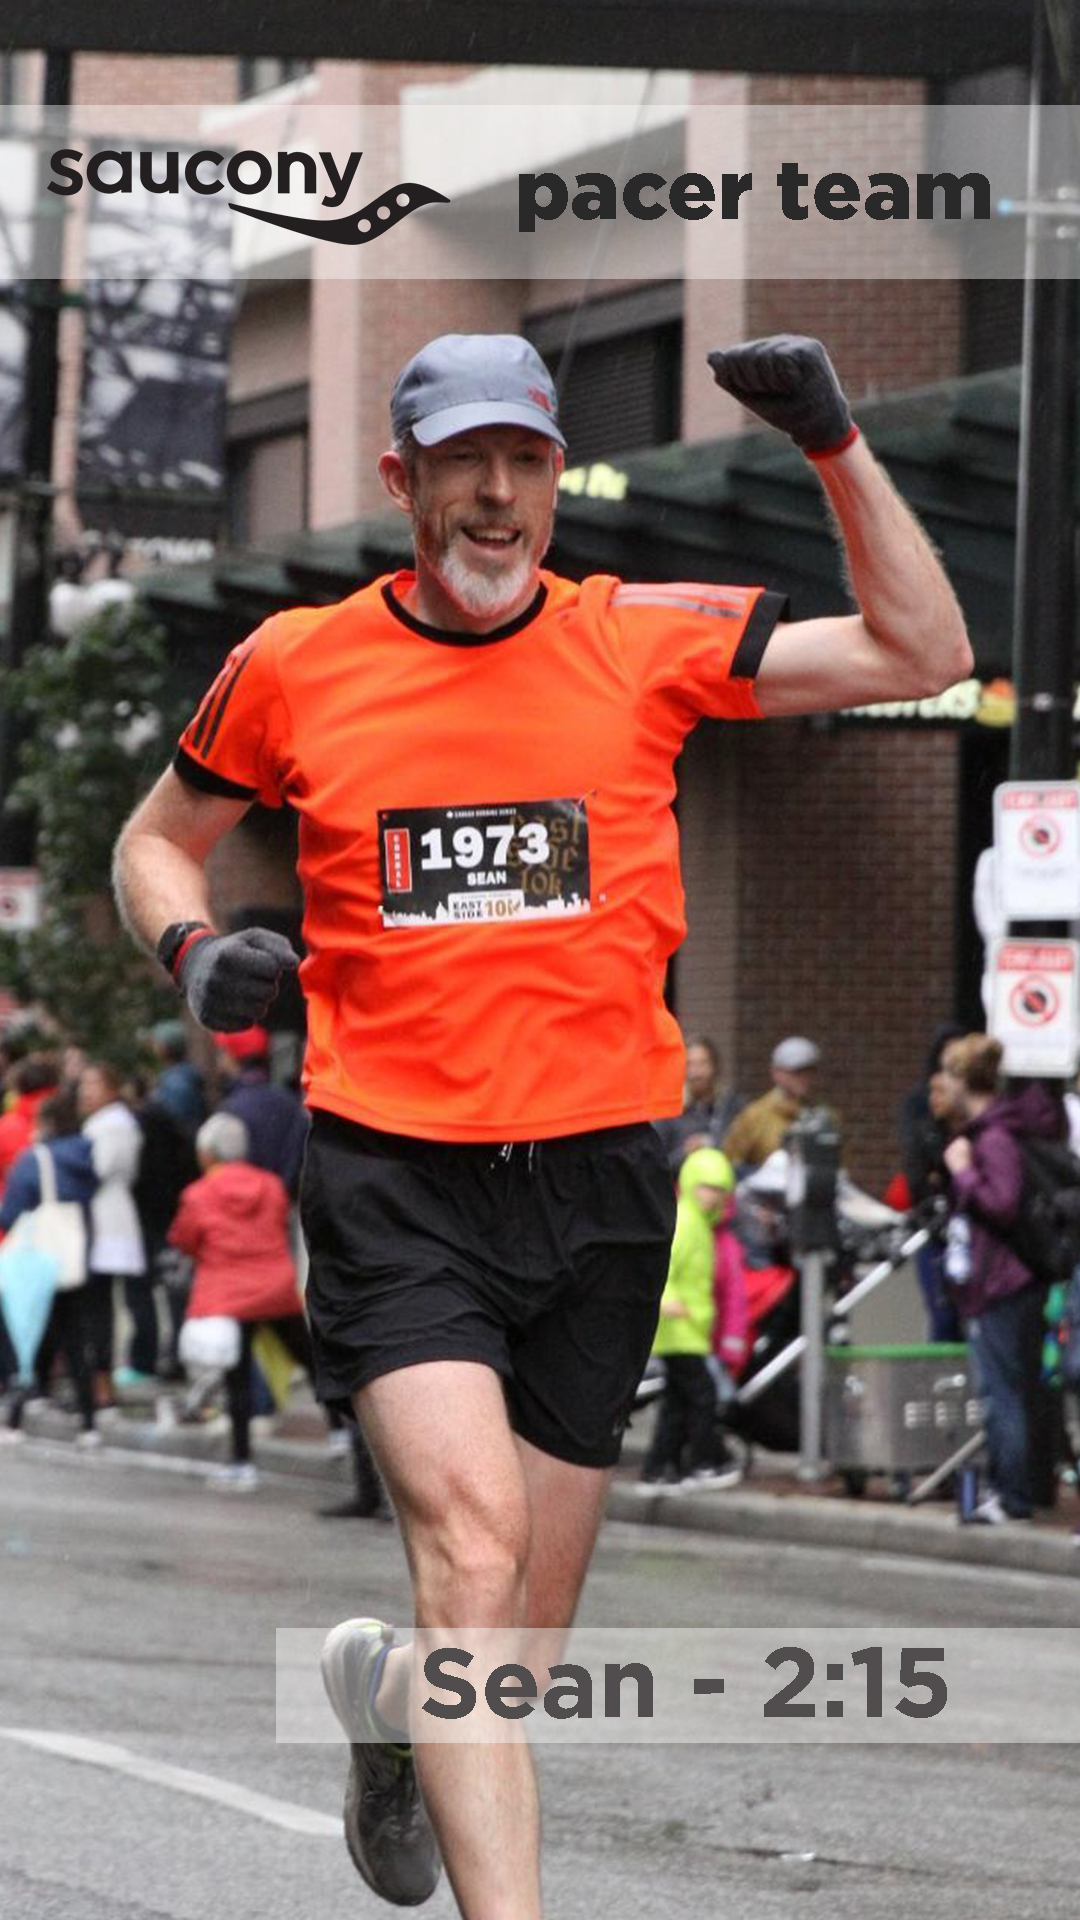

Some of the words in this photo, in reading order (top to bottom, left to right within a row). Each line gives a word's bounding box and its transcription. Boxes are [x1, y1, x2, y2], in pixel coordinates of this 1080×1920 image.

[420, 822, 551, 871] 1973
[466, 870, 508, 886] SEAN
[452, 900, 482, 910] EAST
[453, 910, 483, 919] SIDE
